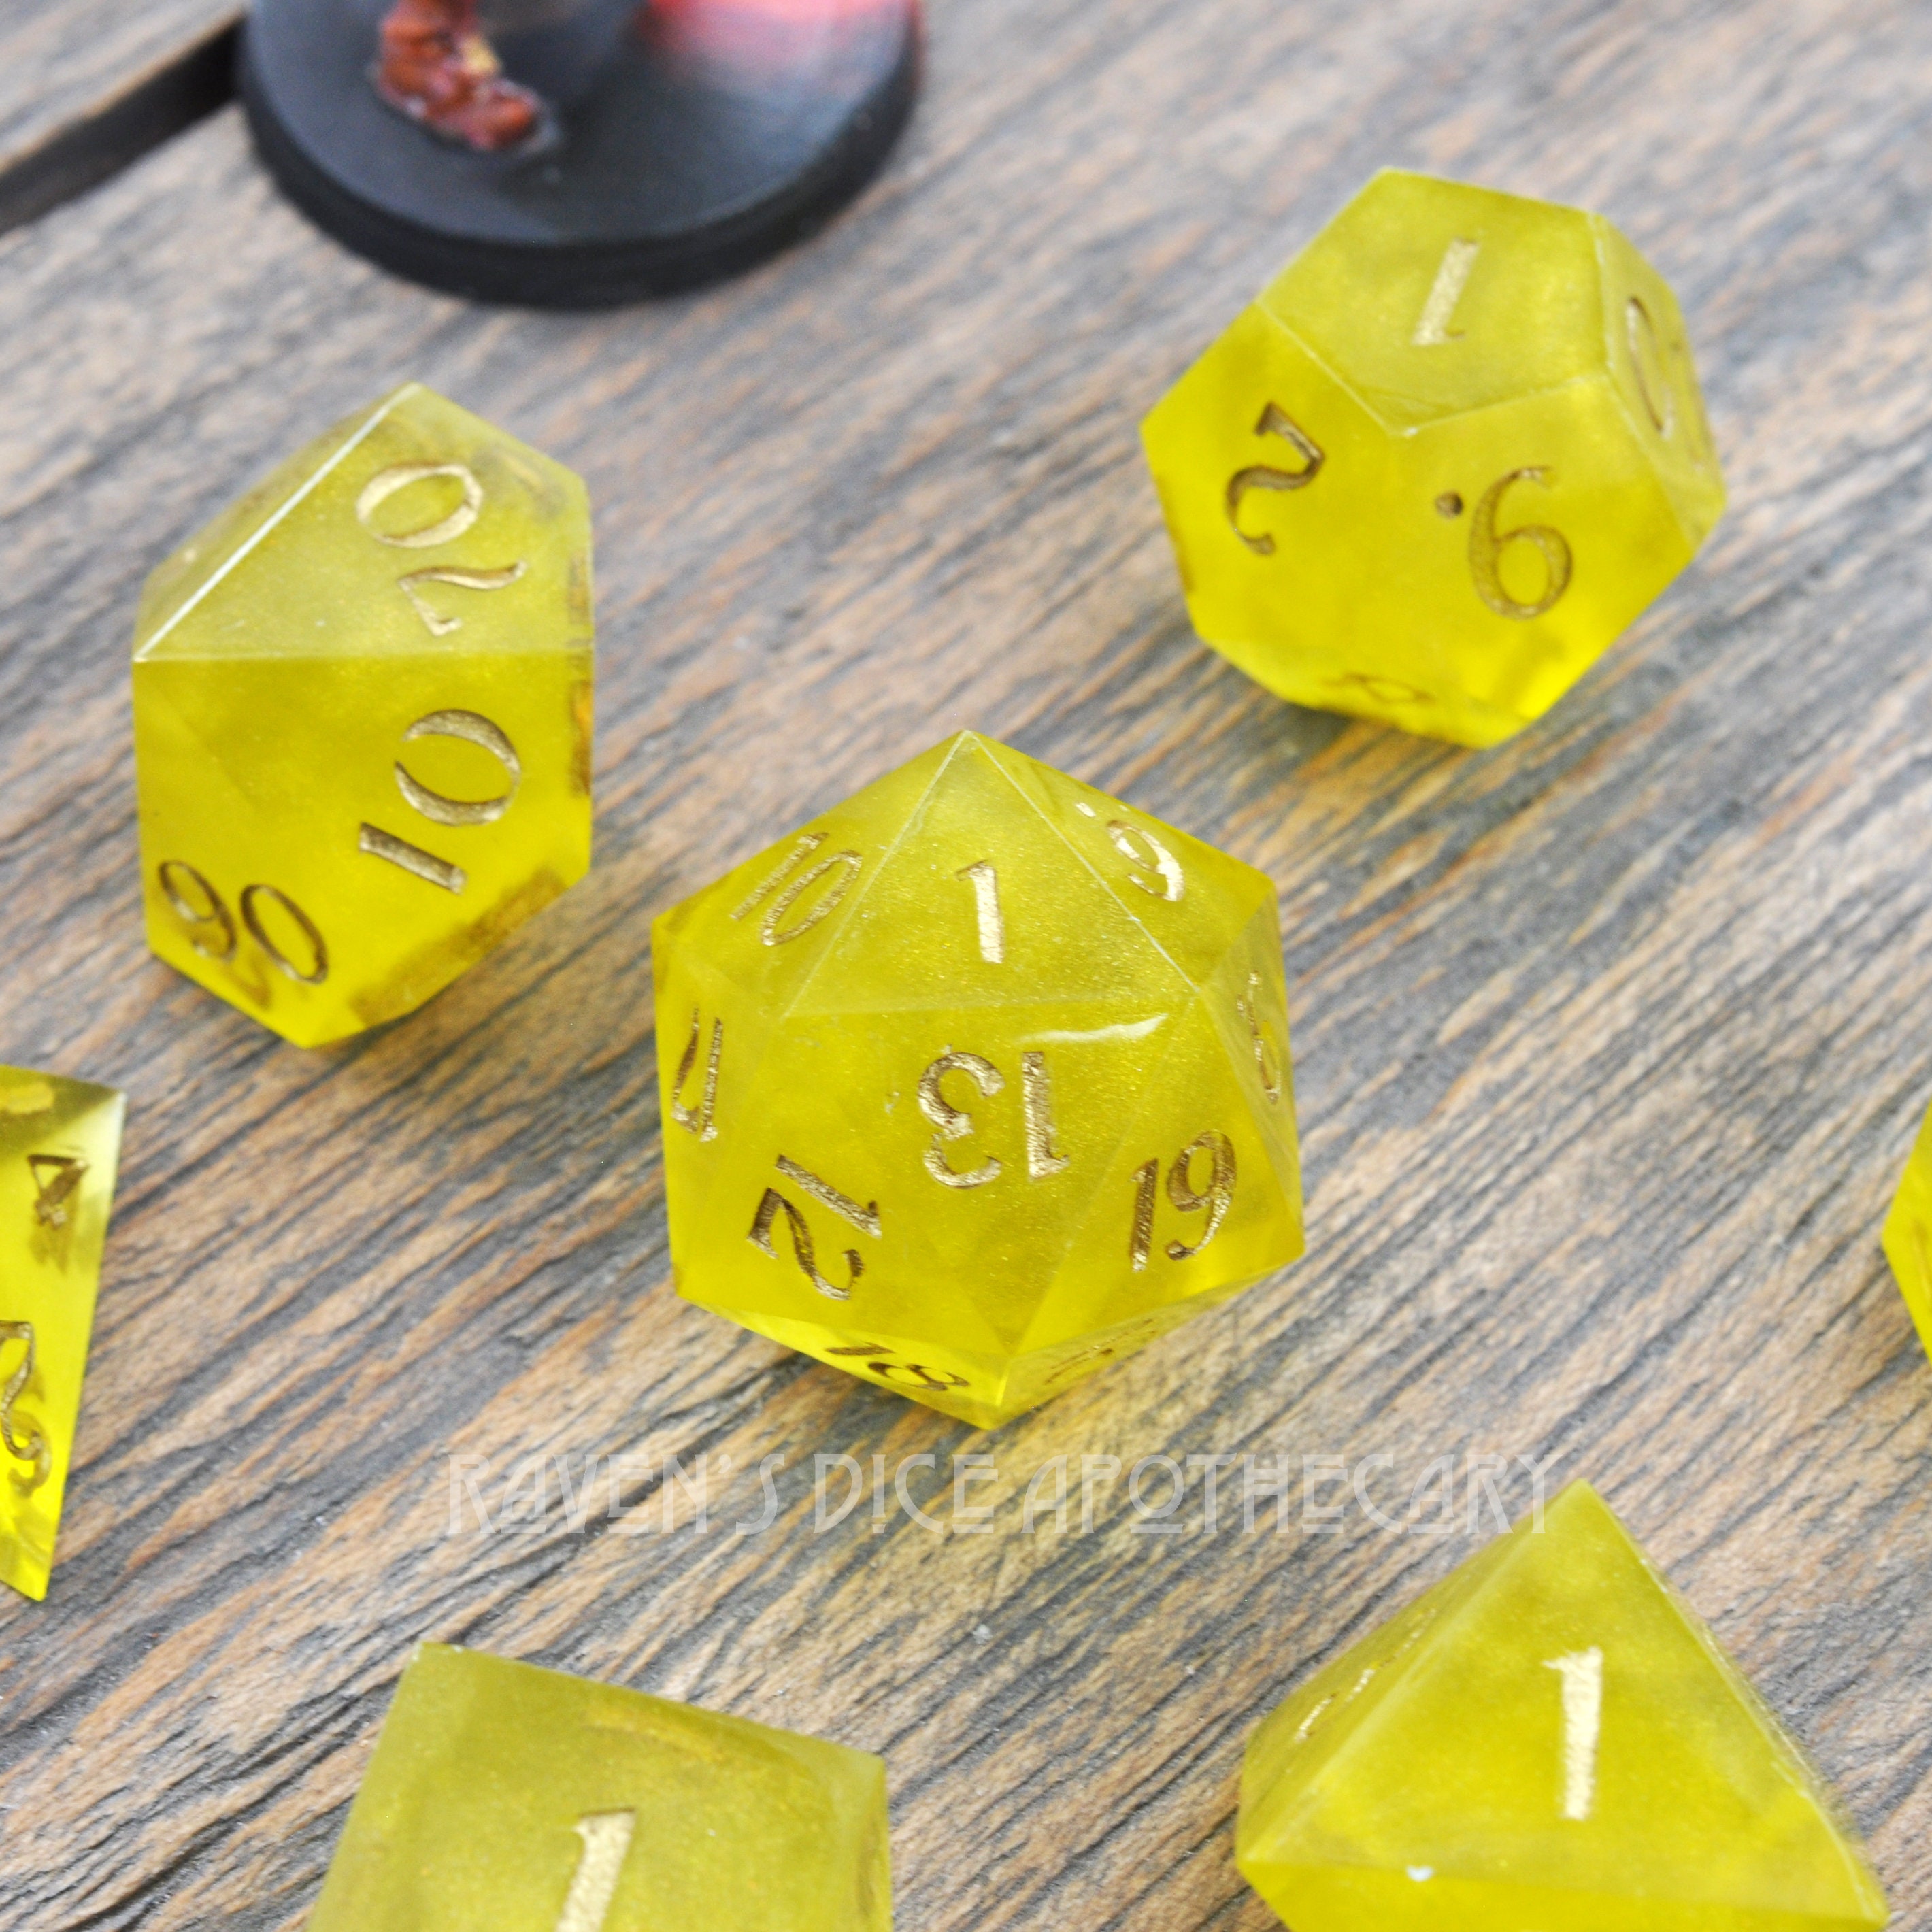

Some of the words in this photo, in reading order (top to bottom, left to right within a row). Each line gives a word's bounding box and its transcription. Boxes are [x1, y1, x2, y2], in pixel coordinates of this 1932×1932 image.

[358, 709, 522, 895] 10
[157, 859, 329, 986] 90
[729, 831, 863, 946] 10
[956, 859, 1005, 964] 1
[916, 1045, 1071, 1190] 13
[746, 1153, 883, 1301] 12
[1131, 1130, 1238, 1273] 19
[1541, 1644, 1603, 1821] 1
